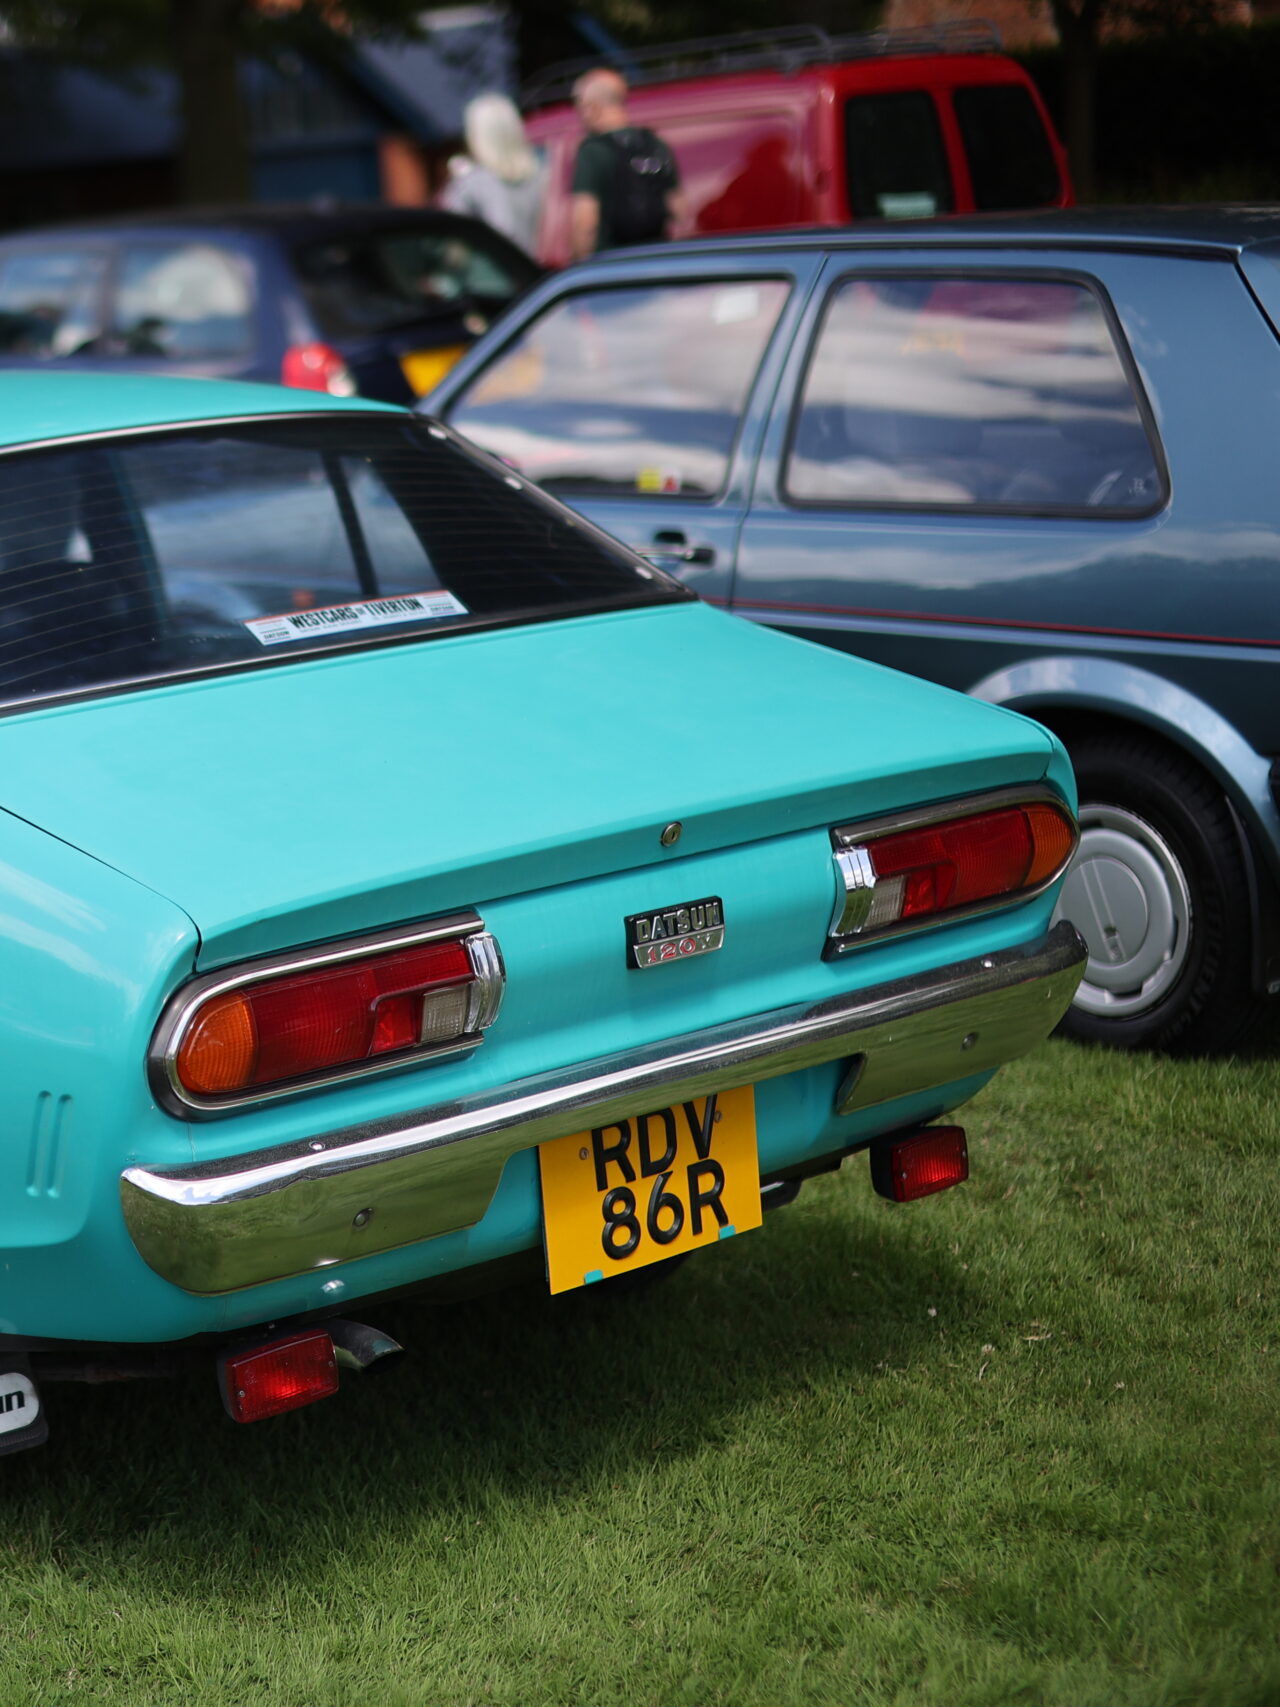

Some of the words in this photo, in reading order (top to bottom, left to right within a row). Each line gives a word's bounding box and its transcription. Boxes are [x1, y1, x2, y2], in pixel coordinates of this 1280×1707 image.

[287, 607, 359, 629] WESTCARS
[362, 597, 424, 616] TIVERTON
[636, 902, 720, 943] DATSUN
[591, 1093, 718, 1192] RDV
[601, 1159, 729, 1260] 86R
